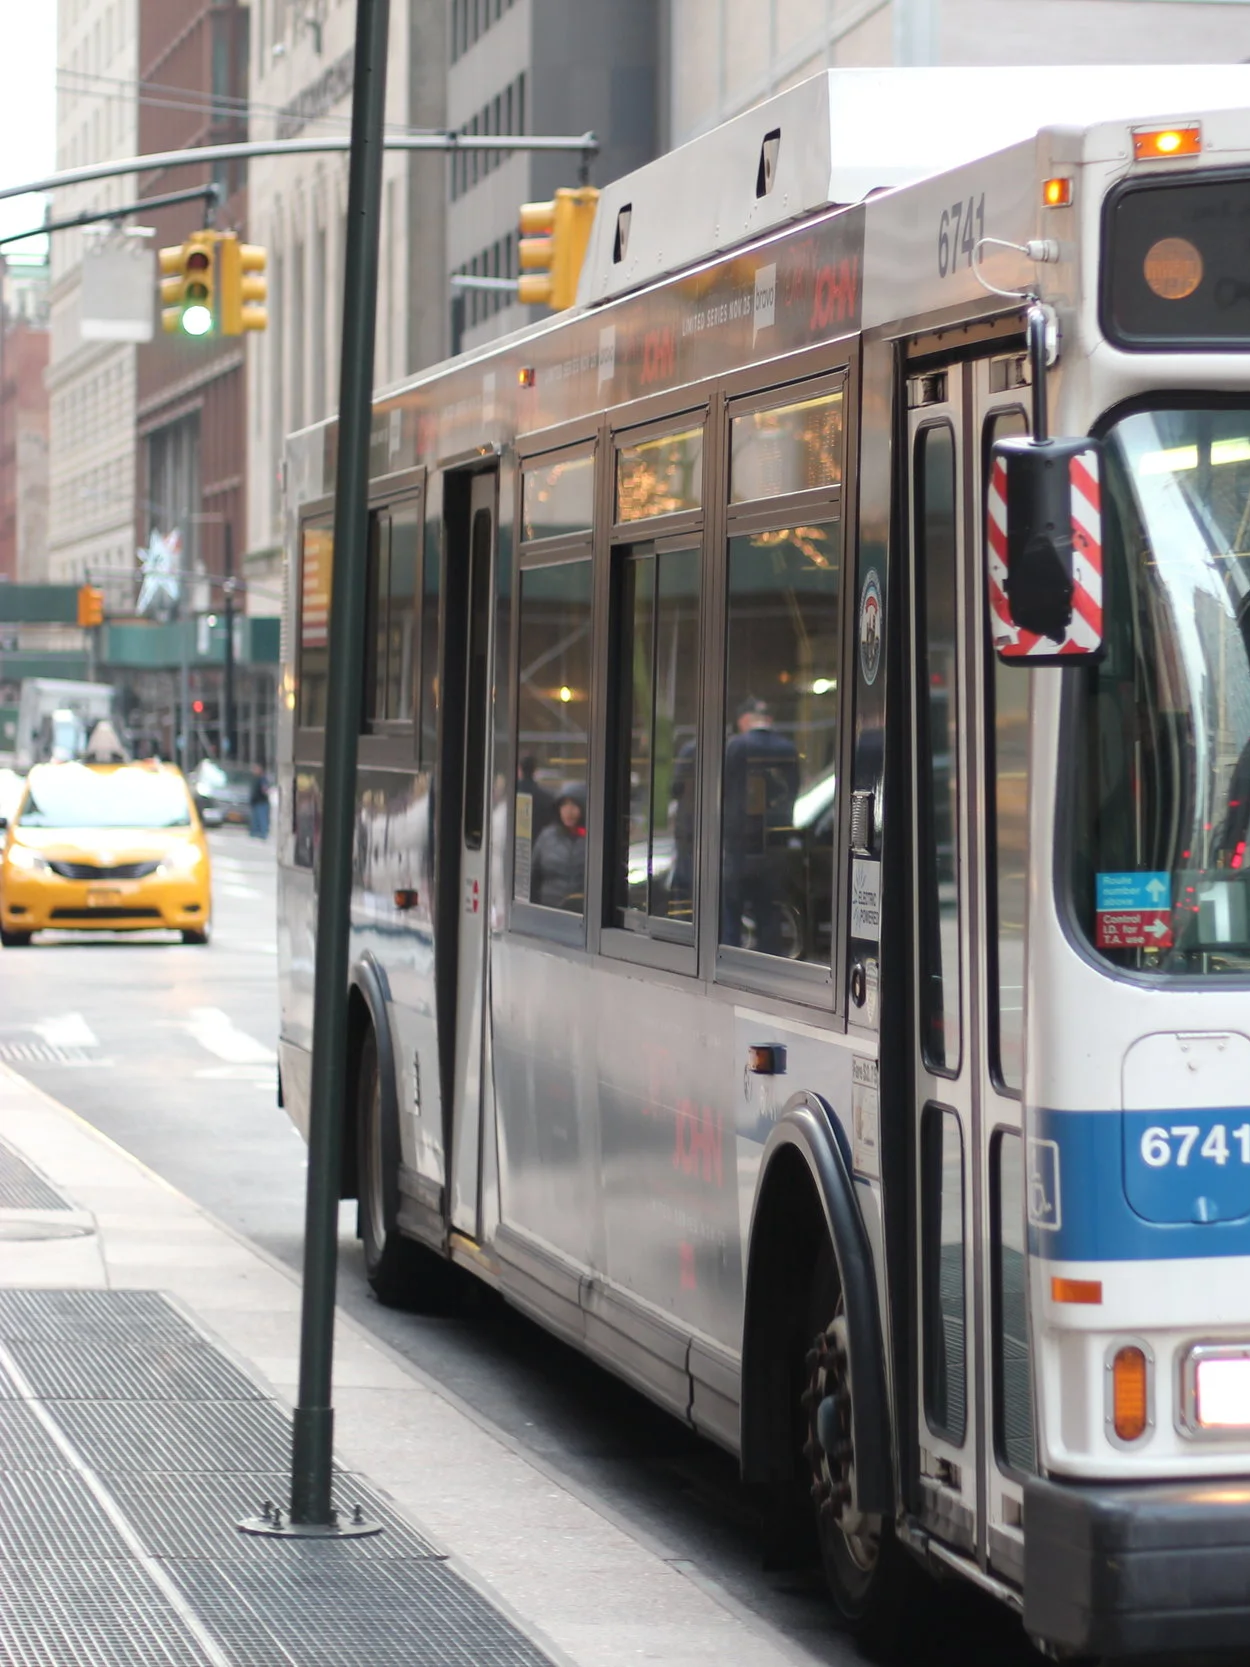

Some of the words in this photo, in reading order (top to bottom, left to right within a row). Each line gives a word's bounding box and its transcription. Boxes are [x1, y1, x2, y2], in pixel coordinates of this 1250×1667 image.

[938, 192, 985, 279] 6741
[1103, 914, 1142, 924] Control
[1199, 881, 1231, 942] 1
